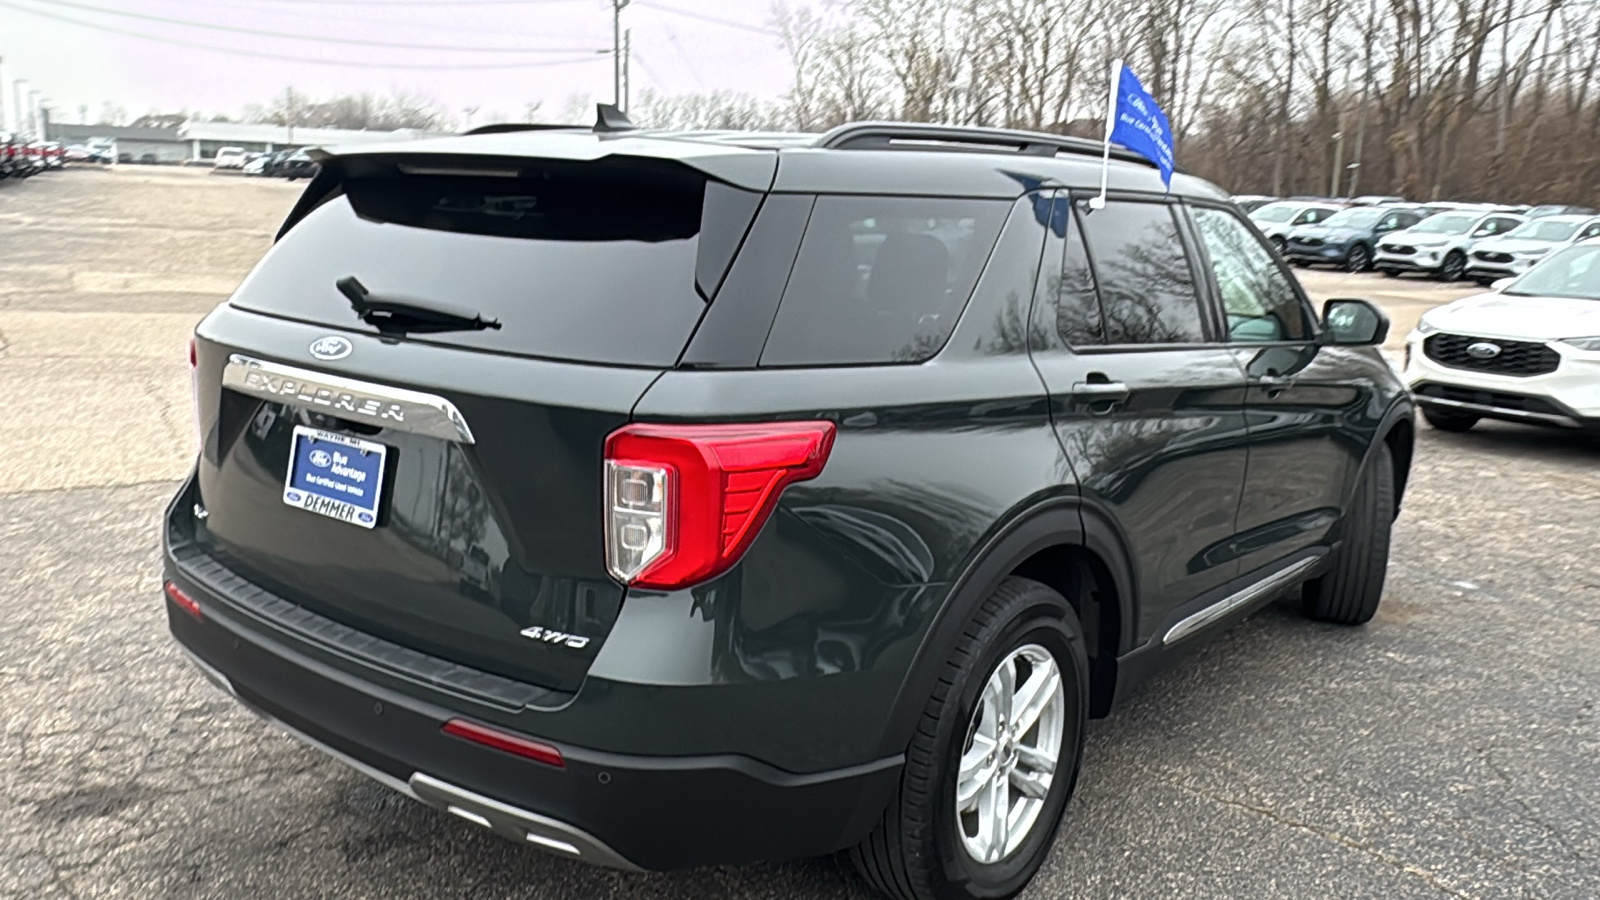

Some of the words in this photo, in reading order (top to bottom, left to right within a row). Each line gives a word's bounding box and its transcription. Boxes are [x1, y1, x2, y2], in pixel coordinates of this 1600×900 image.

[245, 371, 404, 422] EXPLORER
[333, 451, 348, 466] Blue
[331, 464, 367, 483] Advantage
[303, 493, 356, 522] DEMMER
[520, 626, 590, 648] 4WD
